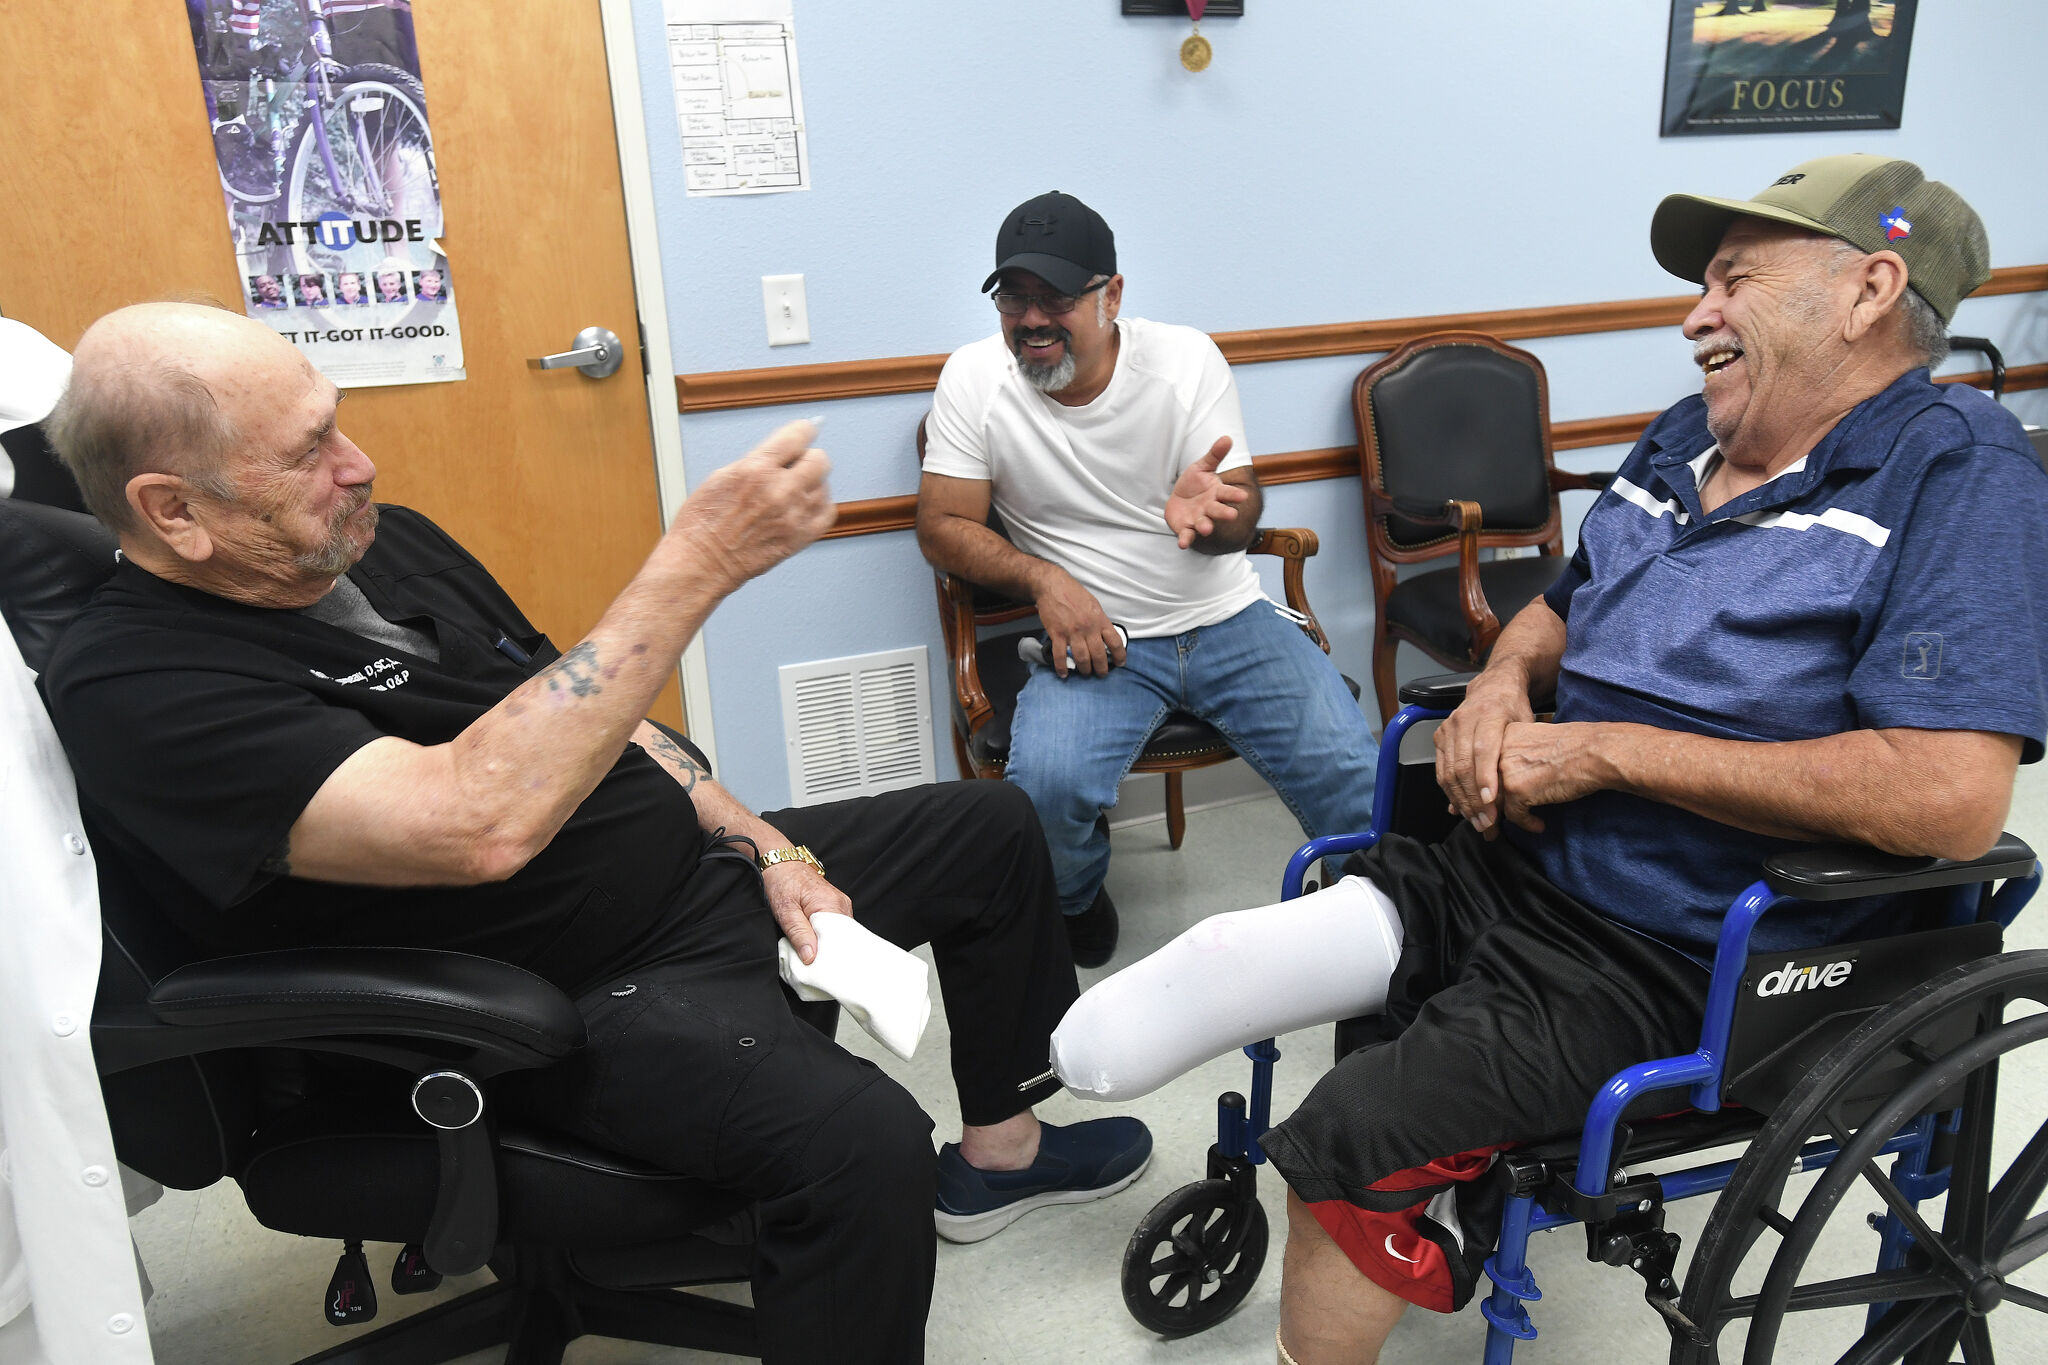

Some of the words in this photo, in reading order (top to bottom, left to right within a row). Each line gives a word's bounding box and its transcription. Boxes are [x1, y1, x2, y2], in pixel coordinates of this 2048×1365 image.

[1731, 78, 1846, 111] FOCUS
[257, 219, 425, 246] ATTITUDE
[304, 328, 364, 343] IT-GOT
[370, 325, 450, 340] IT-GOOD.
[1756, 961, 1853, 998] drive
